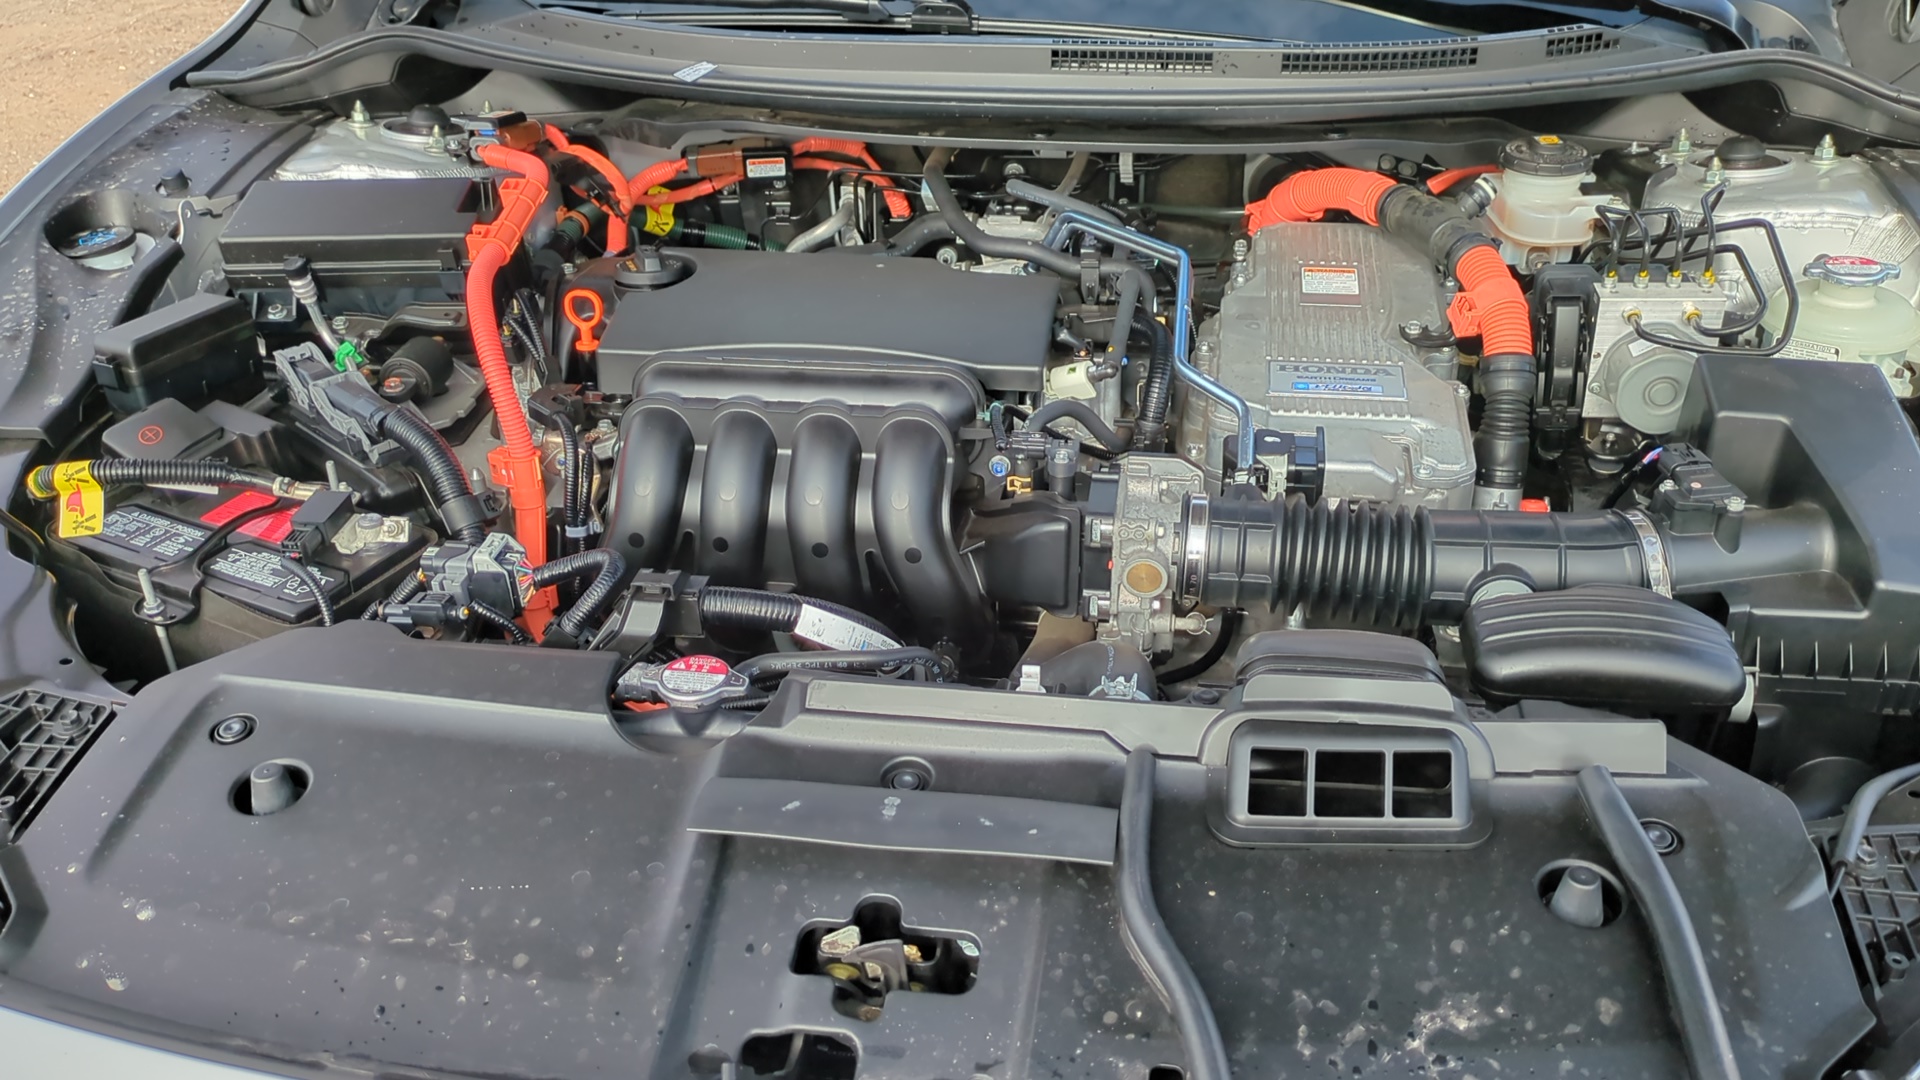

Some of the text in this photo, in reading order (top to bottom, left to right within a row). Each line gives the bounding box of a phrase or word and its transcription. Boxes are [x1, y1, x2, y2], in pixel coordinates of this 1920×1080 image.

[1787, 340, 1832, 352] NFORMATION
[1276, 364, 1397, 377] HONDA
[139, 513, 171, 527] DANGER
[174, 524, 205, 537] POISON
